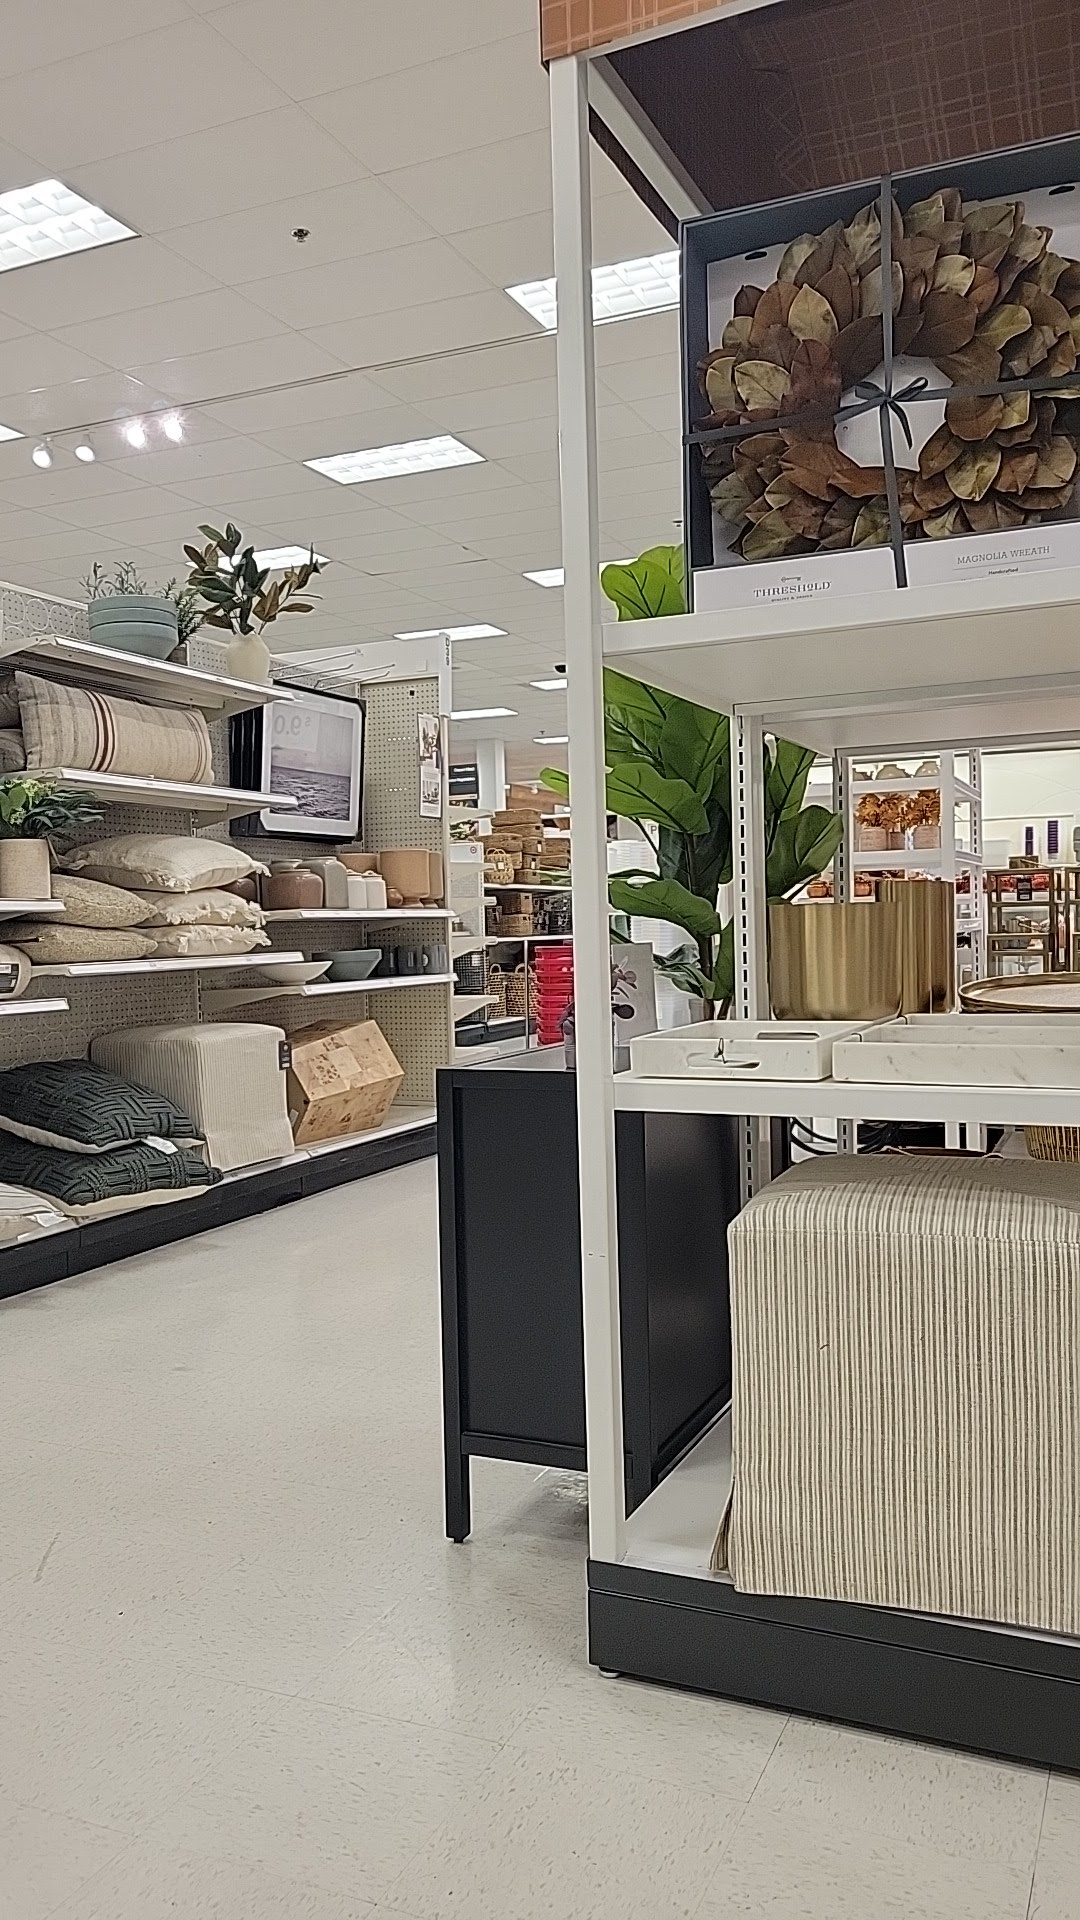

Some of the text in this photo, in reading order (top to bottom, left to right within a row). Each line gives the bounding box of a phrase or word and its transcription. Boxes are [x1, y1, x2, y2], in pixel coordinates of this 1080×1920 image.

[957, 545, 1050, 565] MAGNOLIA WREATH
[753, 581, 832, 598] THRESHOLD
